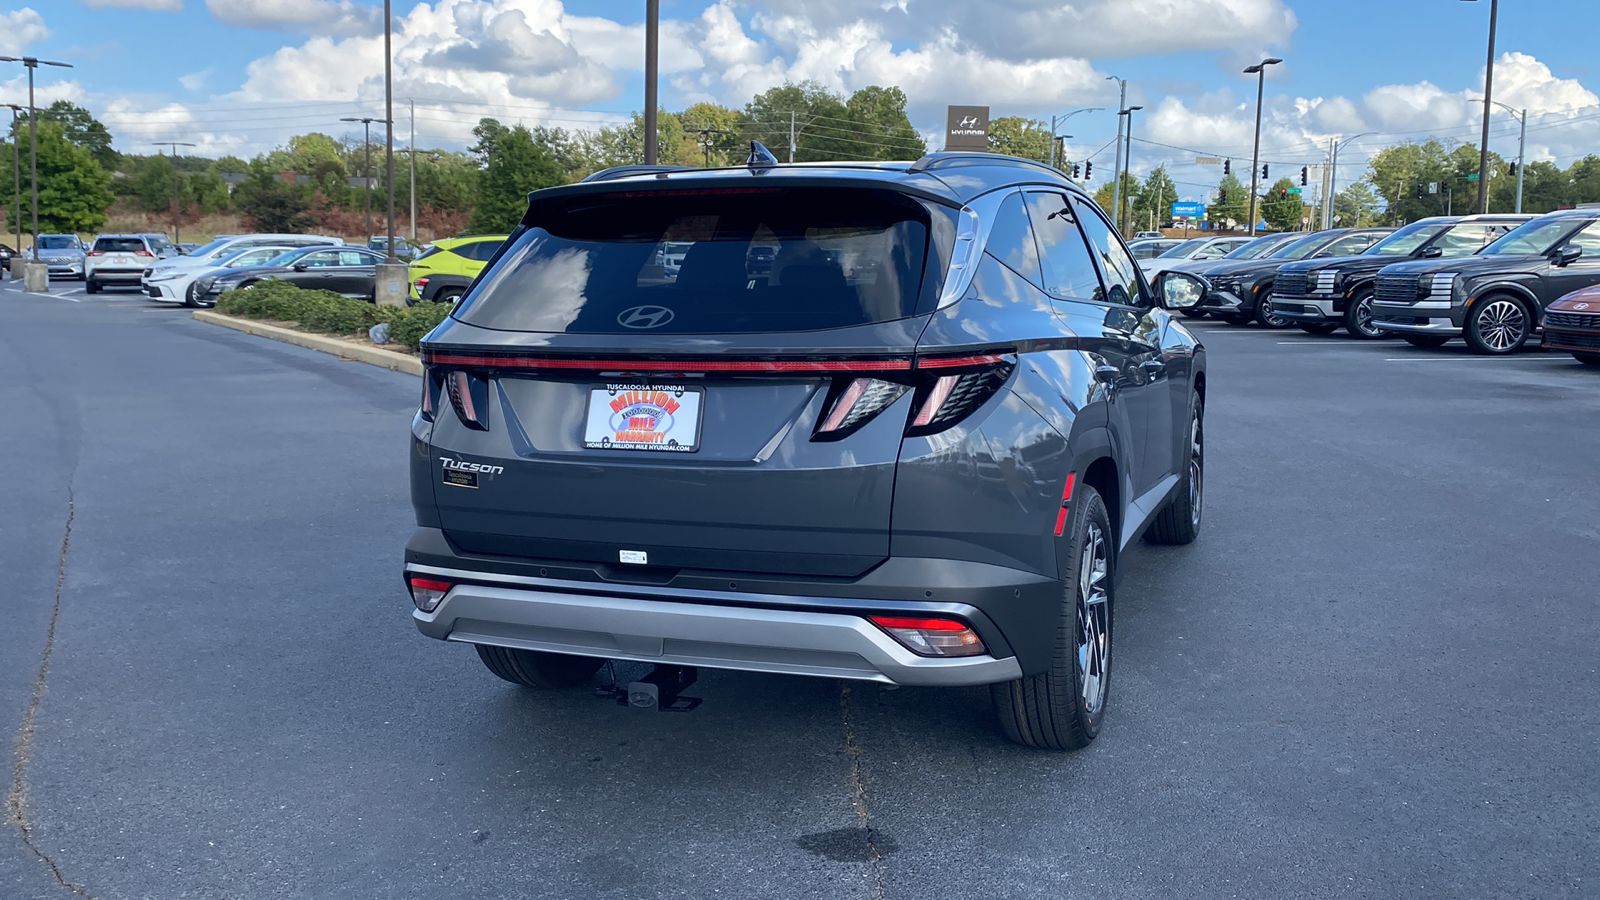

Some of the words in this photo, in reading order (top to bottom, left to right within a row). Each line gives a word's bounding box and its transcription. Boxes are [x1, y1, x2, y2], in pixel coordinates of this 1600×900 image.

[609, 390, 680, 415] MILLION
[628, 417, 655, 431] MILE
[615, 431, 666, 443] WARRANTY
